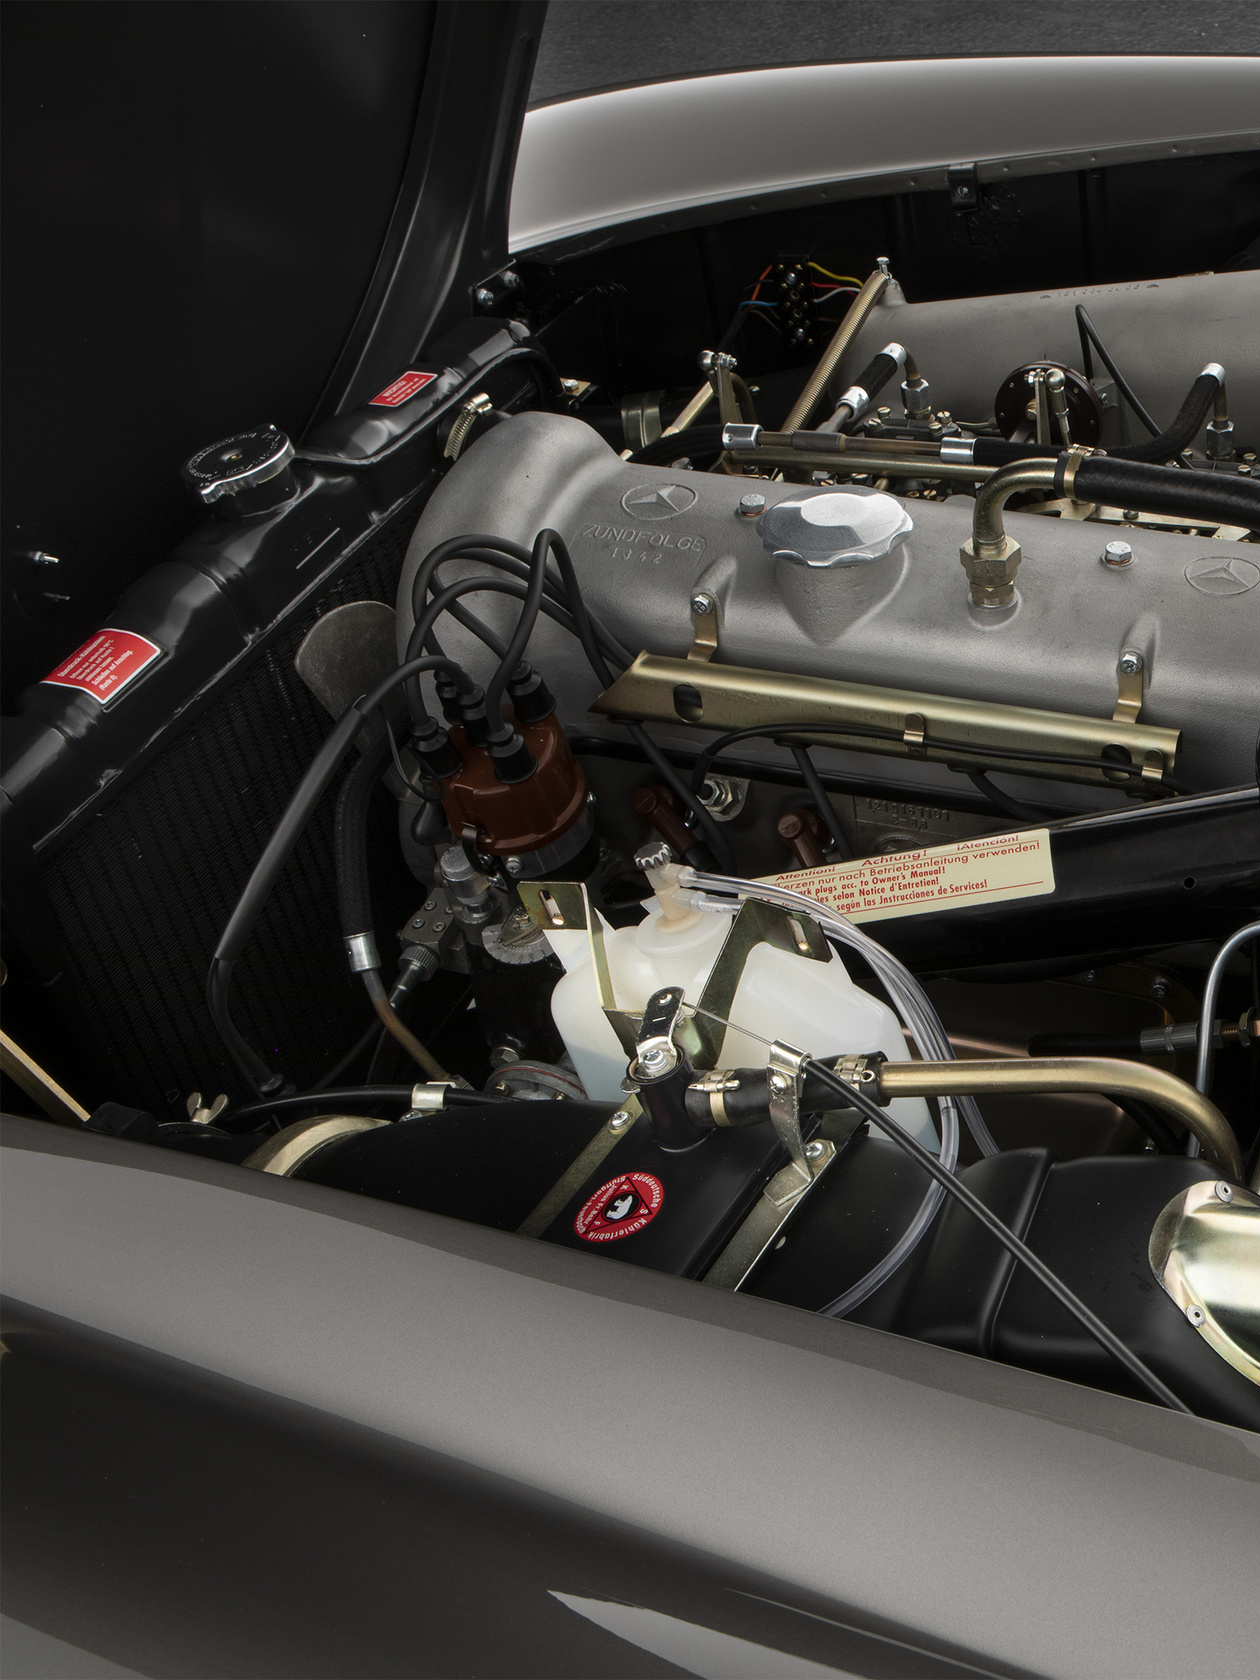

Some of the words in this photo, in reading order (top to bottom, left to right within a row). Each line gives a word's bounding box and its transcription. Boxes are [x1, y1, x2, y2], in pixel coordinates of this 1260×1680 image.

[775, 866, 836, 881] Attention!
[861, 849, 927, 867] Achtung!
[957, 835, 1019, 851] ¡Atención!
[818, 877, 836, 885] nur
[839, 869, 866, 880] nach
[869, 854, 969, 877] Betriebsanleitung
[972, 841, 1040, 860] verwenden!
[815, 884, 838, 899] plugs
[841, 882, 857, 890] acc.
[860, 879, 869, 887] to
[872, 872, 906, 885] Owner's
[910, 865, 946, 879] Manual!
[832, 891, 854, 901] selon
[859, 886, 886, 897] Notice
[889, 876, 939, 892] d'Entretien!
[836, 899, 861, 913] según
[863, 897, 876, 907] las
[938, 884, 948, 895] de
[949, 878, 988, 894] Services!
[632, 1173, 662, 1208] Süddeutsche
[588, 1217, 648, 1241] Kühlerfabrik
